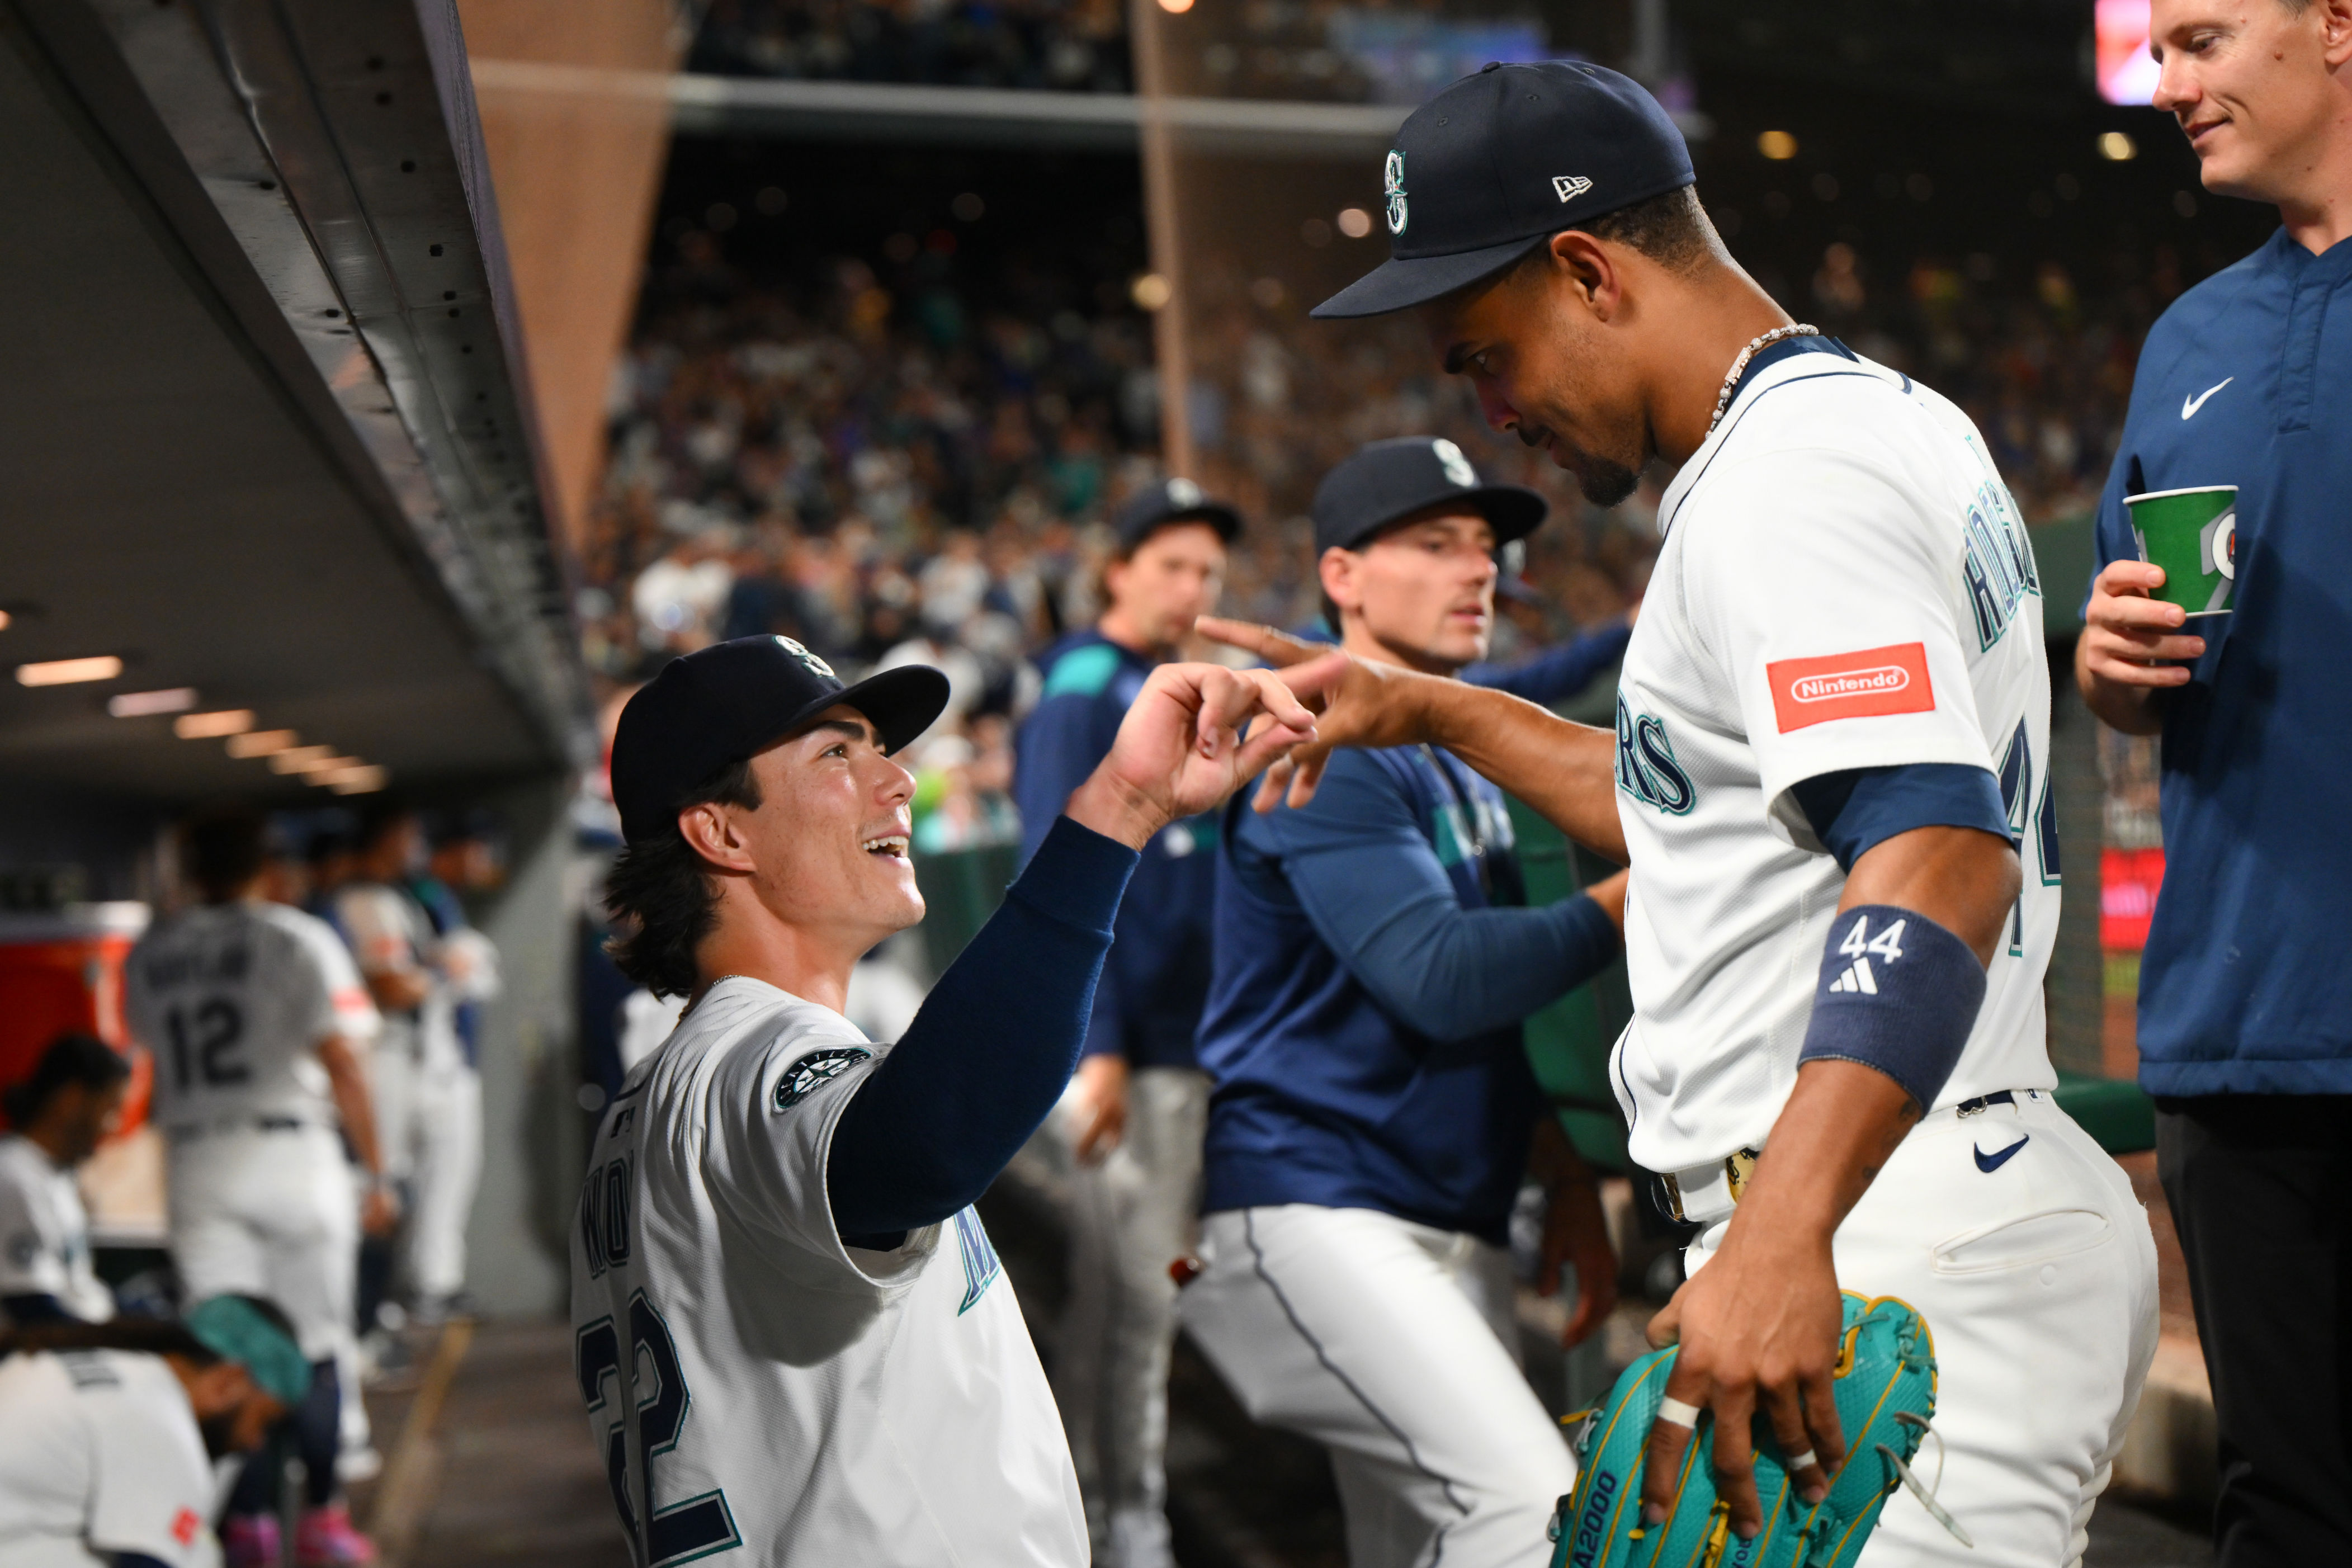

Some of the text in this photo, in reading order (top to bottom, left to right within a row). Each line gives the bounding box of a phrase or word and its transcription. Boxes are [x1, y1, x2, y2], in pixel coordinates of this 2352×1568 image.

[1801, 672, 1899, 698] Nintendo
[1839, 914, 1906, 964] 44
[163, 995, 253, 1094] 12
